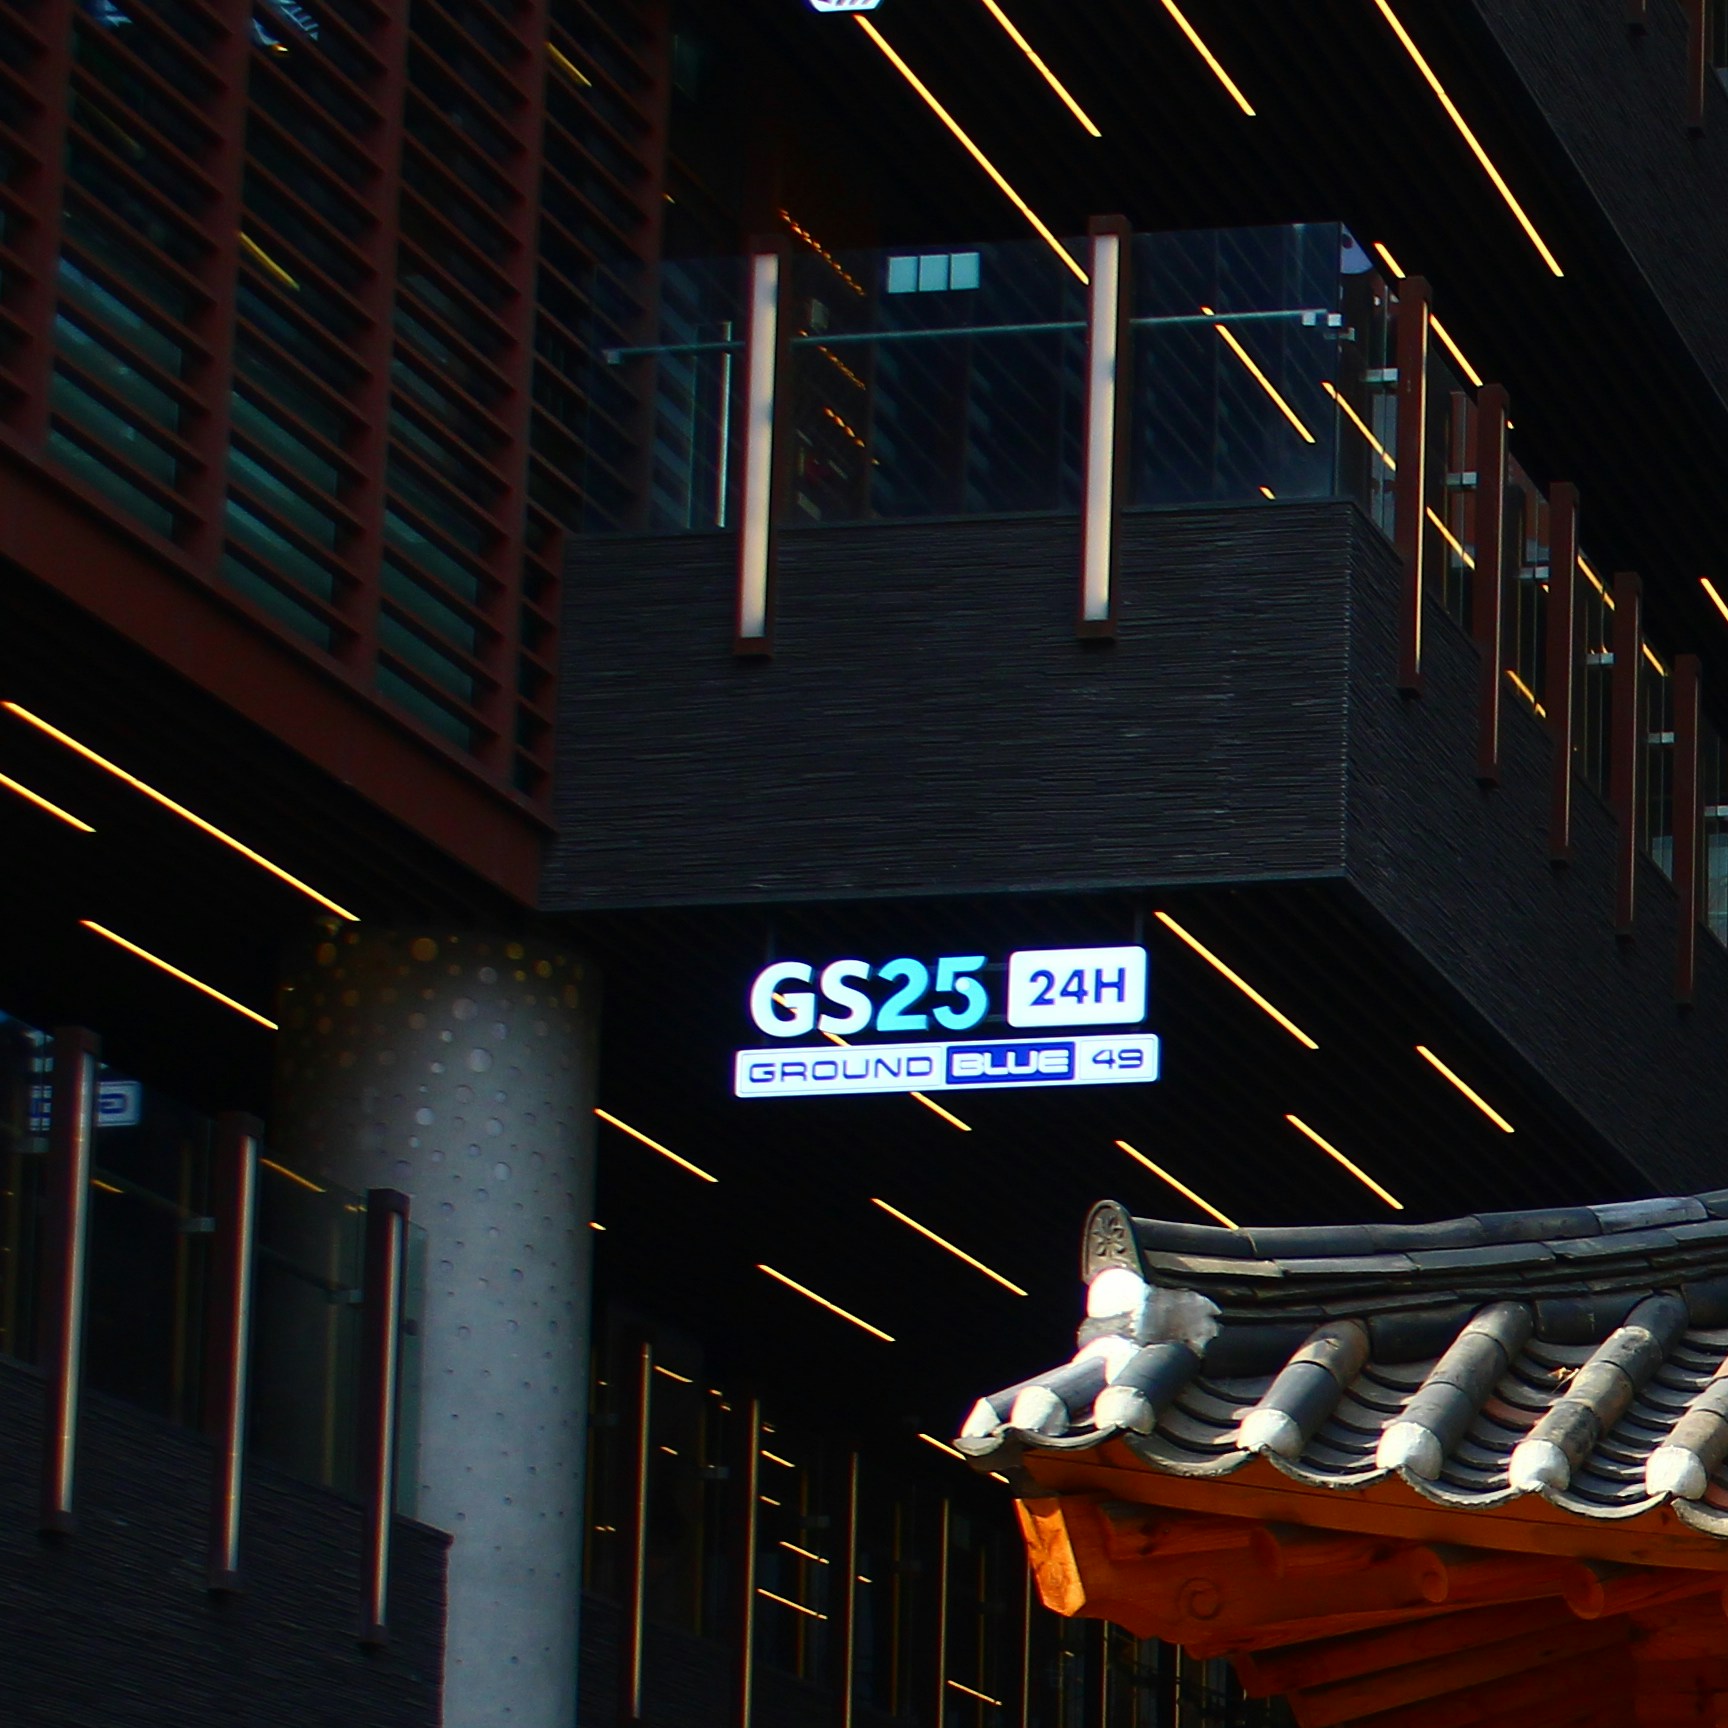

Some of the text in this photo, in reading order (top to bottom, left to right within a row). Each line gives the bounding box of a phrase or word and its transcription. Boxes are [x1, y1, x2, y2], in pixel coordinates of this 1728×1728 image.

[750, 955, 990, 1037] GS25
[1029, 967, 1126, 1007] 24H
[749, 1048, 1144, 1083] GROUND BLUE 49
